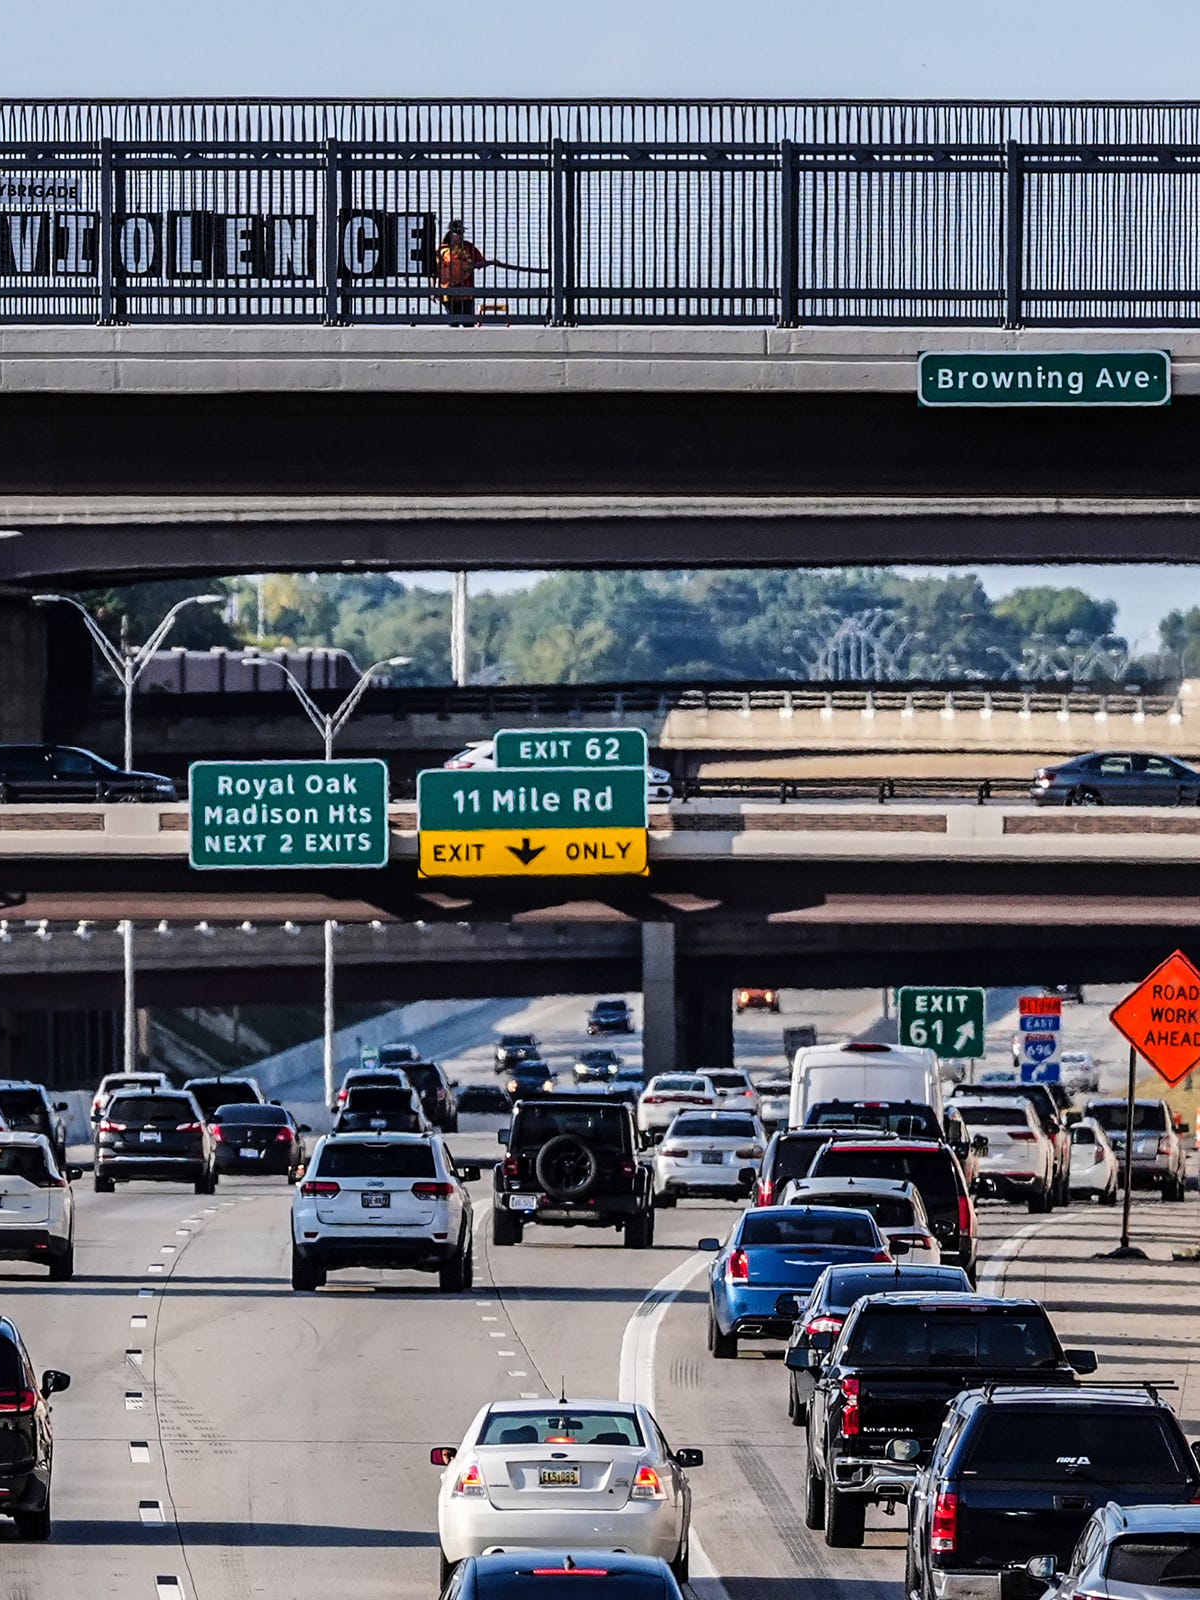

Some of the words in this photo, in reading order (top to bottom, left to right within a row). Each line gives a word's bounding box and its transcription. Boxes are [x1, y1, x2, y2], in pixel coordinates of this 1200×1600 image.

[6, 214, 424, 276] VIOLENCE
[937, 366, 1084, 394] Browning
[1095, 367, 1150, 389] Ave
[519, 740, 572, 760] EXIT
[585, 737, 621, 761] 62
[217, 773, 295, 800] Royal
[304, 773, 358, 795] Oak
[452, 788, 481, 814] 11
[492, 786, 561, 813] Mile
[572, 785, 614, 813] Rd
[204, 803, 319, 826] Madison
[328, 804, 373, 825] Hts
[204, 833, 267, 853] NEXT
[279, 833, 294, 854] 2
[305, 832, 372, 853] EXITS
[433, 843, 485, 862] EXIT
[565, 841, 632, 861] ONLY
[1153, 984, 1199, 1000] ROAD
[915, 995, 969, 1013] EXIT
[1151, 1007, 1199, 1024] WORK
[909, 1019, 944, 1046] 61
[1144, 1030, 1200, 1047] AHEAD
[1027, 1043, 1052, 1057] 696
